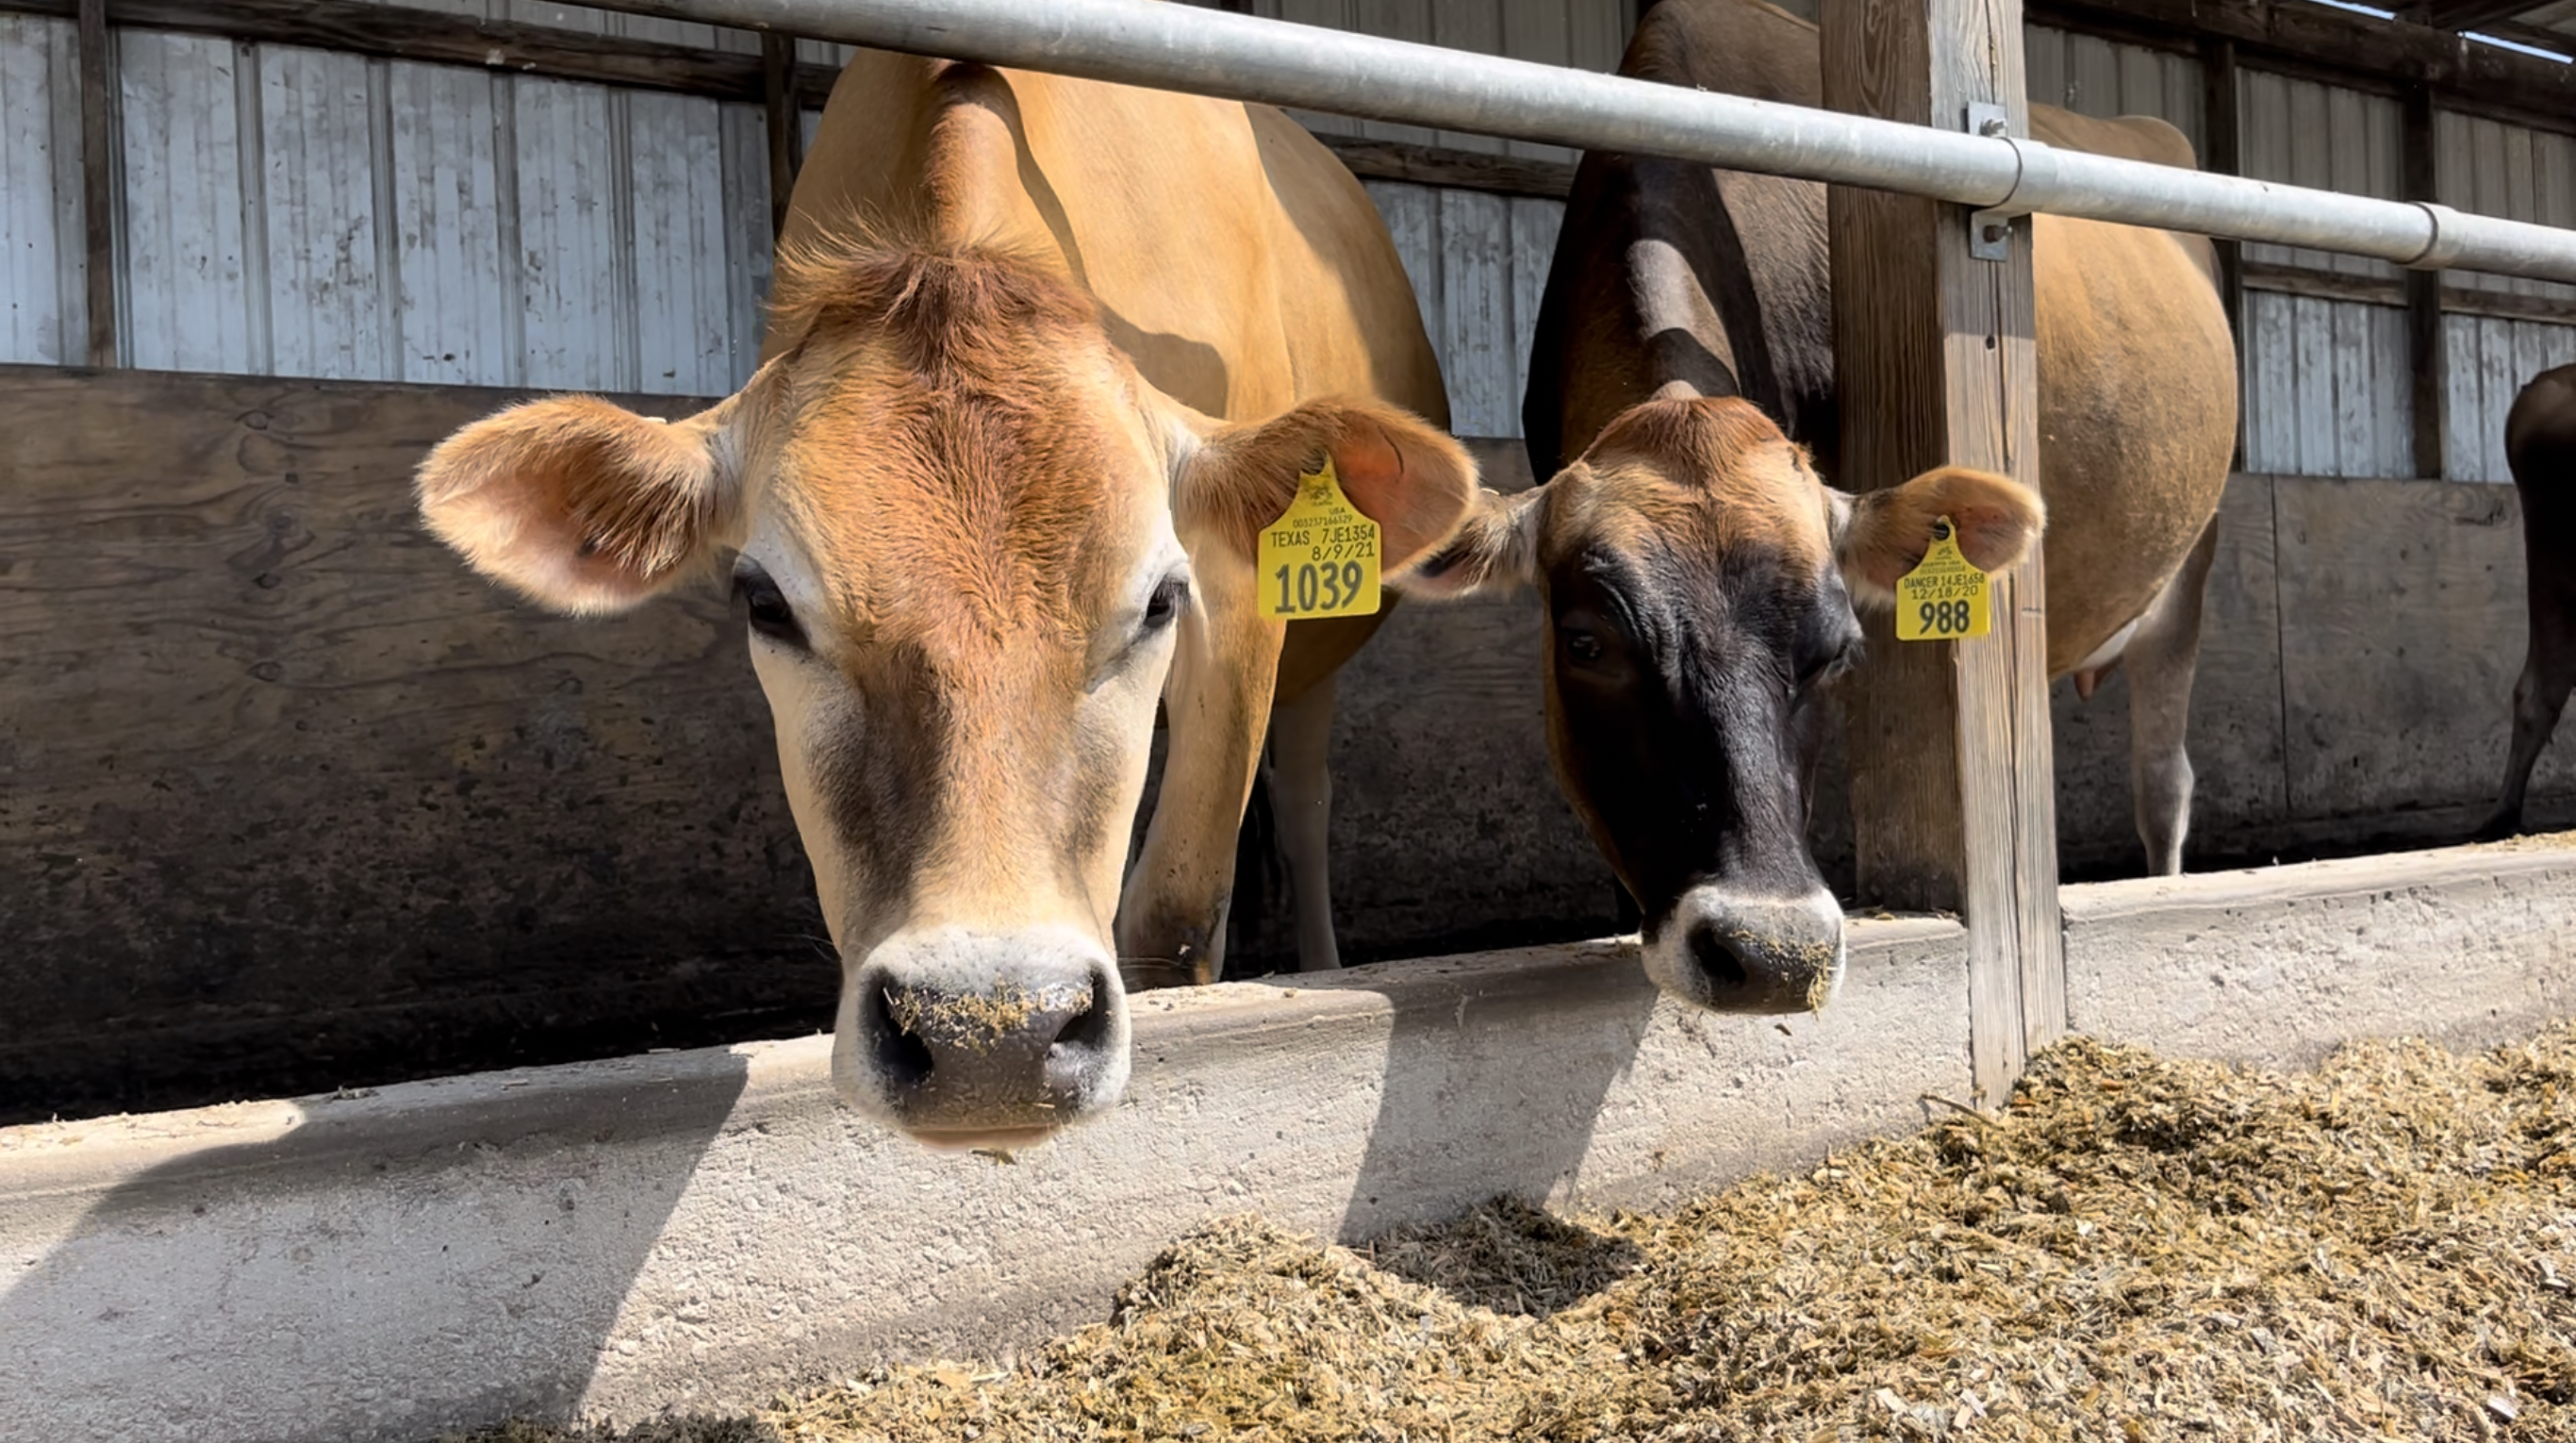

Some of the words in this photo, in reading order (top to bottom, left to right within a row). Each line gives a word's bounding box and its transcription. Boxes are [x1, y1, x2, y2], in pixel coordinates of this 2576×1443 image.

[1271, 530, 1311, 548] TEXAS
[1321, 524, 1376, 544] 7JE1354
[1312, 541, 1375, 561] 8/9/21
[1275, 560, 1363, 614] 1039
[1904, 576, 1939, 589] DANCER
[1912, 585, 1978, 599] 12/18/20
[1920, 599, 1970, 635] 988
